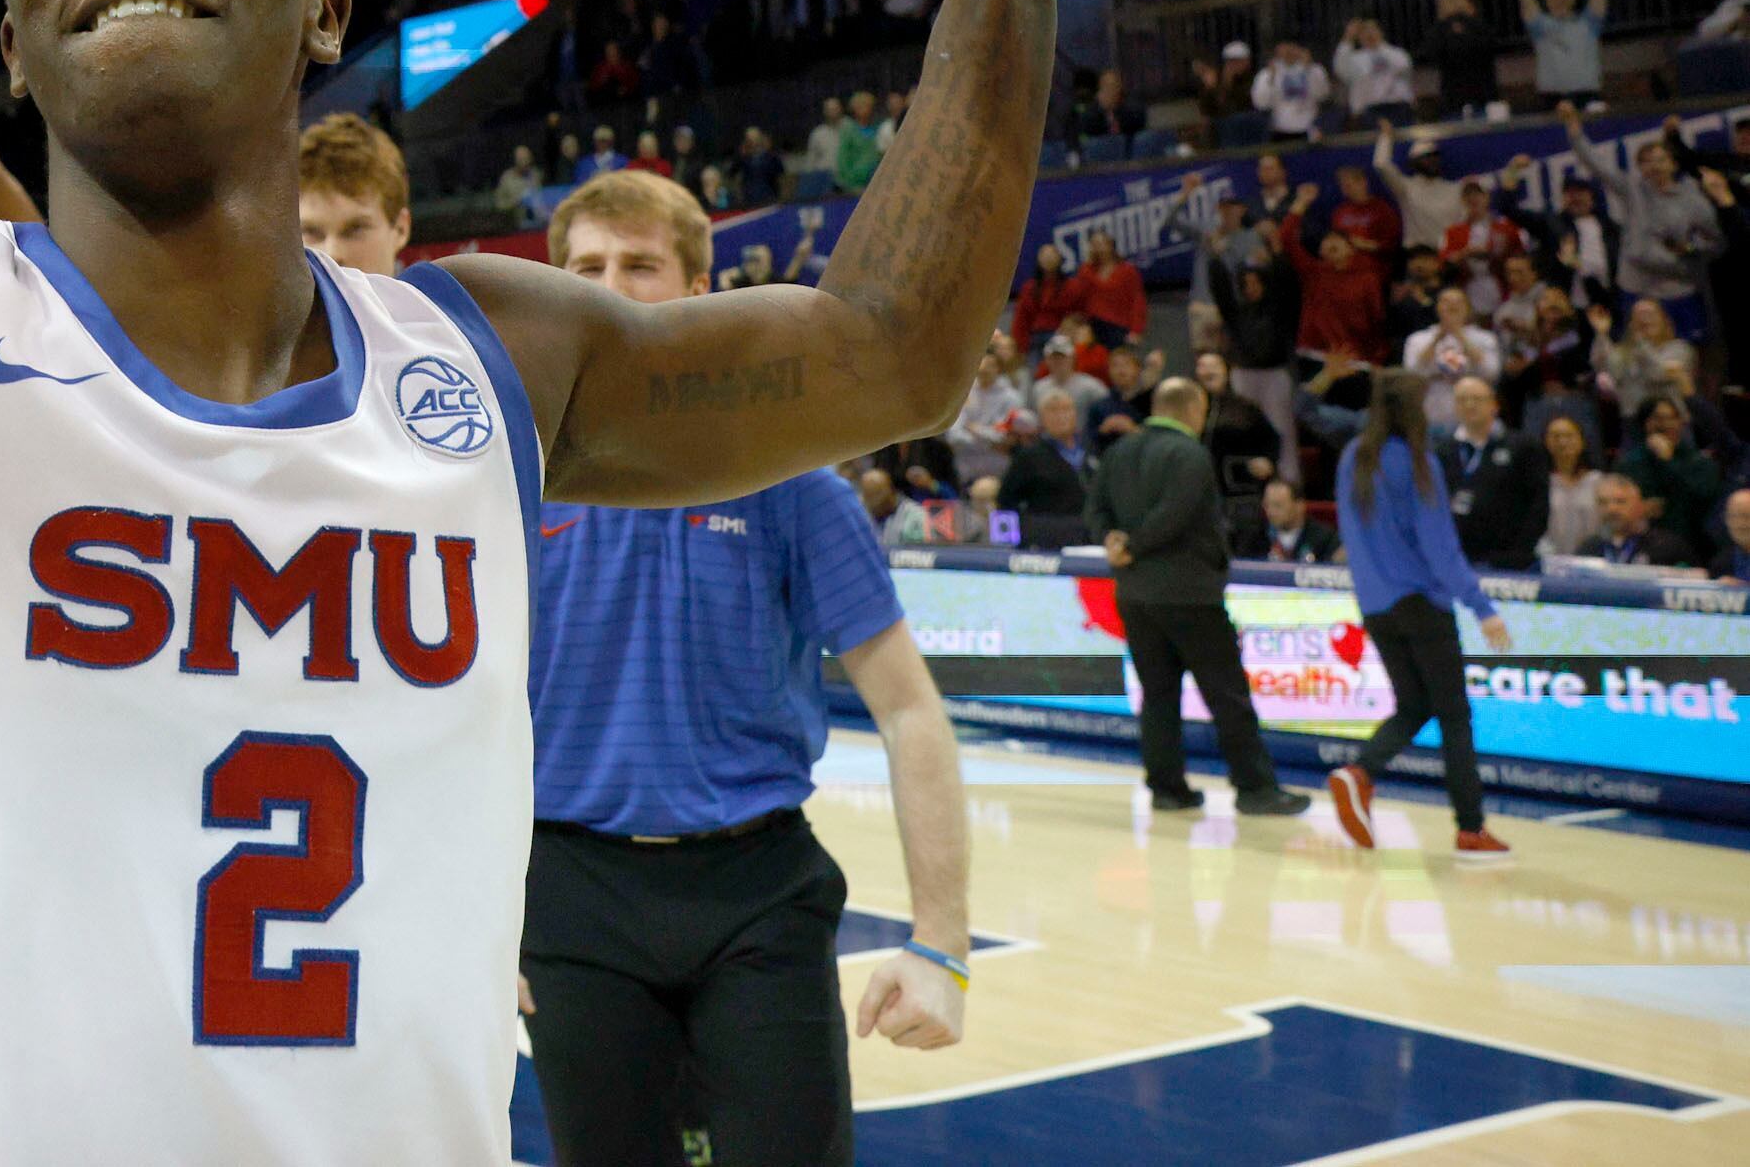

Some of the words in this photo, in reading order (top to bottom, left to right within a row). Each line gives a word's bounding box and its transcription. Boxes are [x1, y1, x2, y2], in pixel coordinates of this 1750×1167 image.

[410, 389, 480, 414] ACC
[25, 505, 479, 688] SMU
[1663, 588, 1747, 614] UTSW
[915, 618, 1003, 655] oard
[1466, 663, 1587, 708] care
[1601, 667, 1739, 723] that
[1500, 761, 1586, 794] Medical
[1586, 772, 1663, 804] Center
[192, 729, 369, 1047] 2
